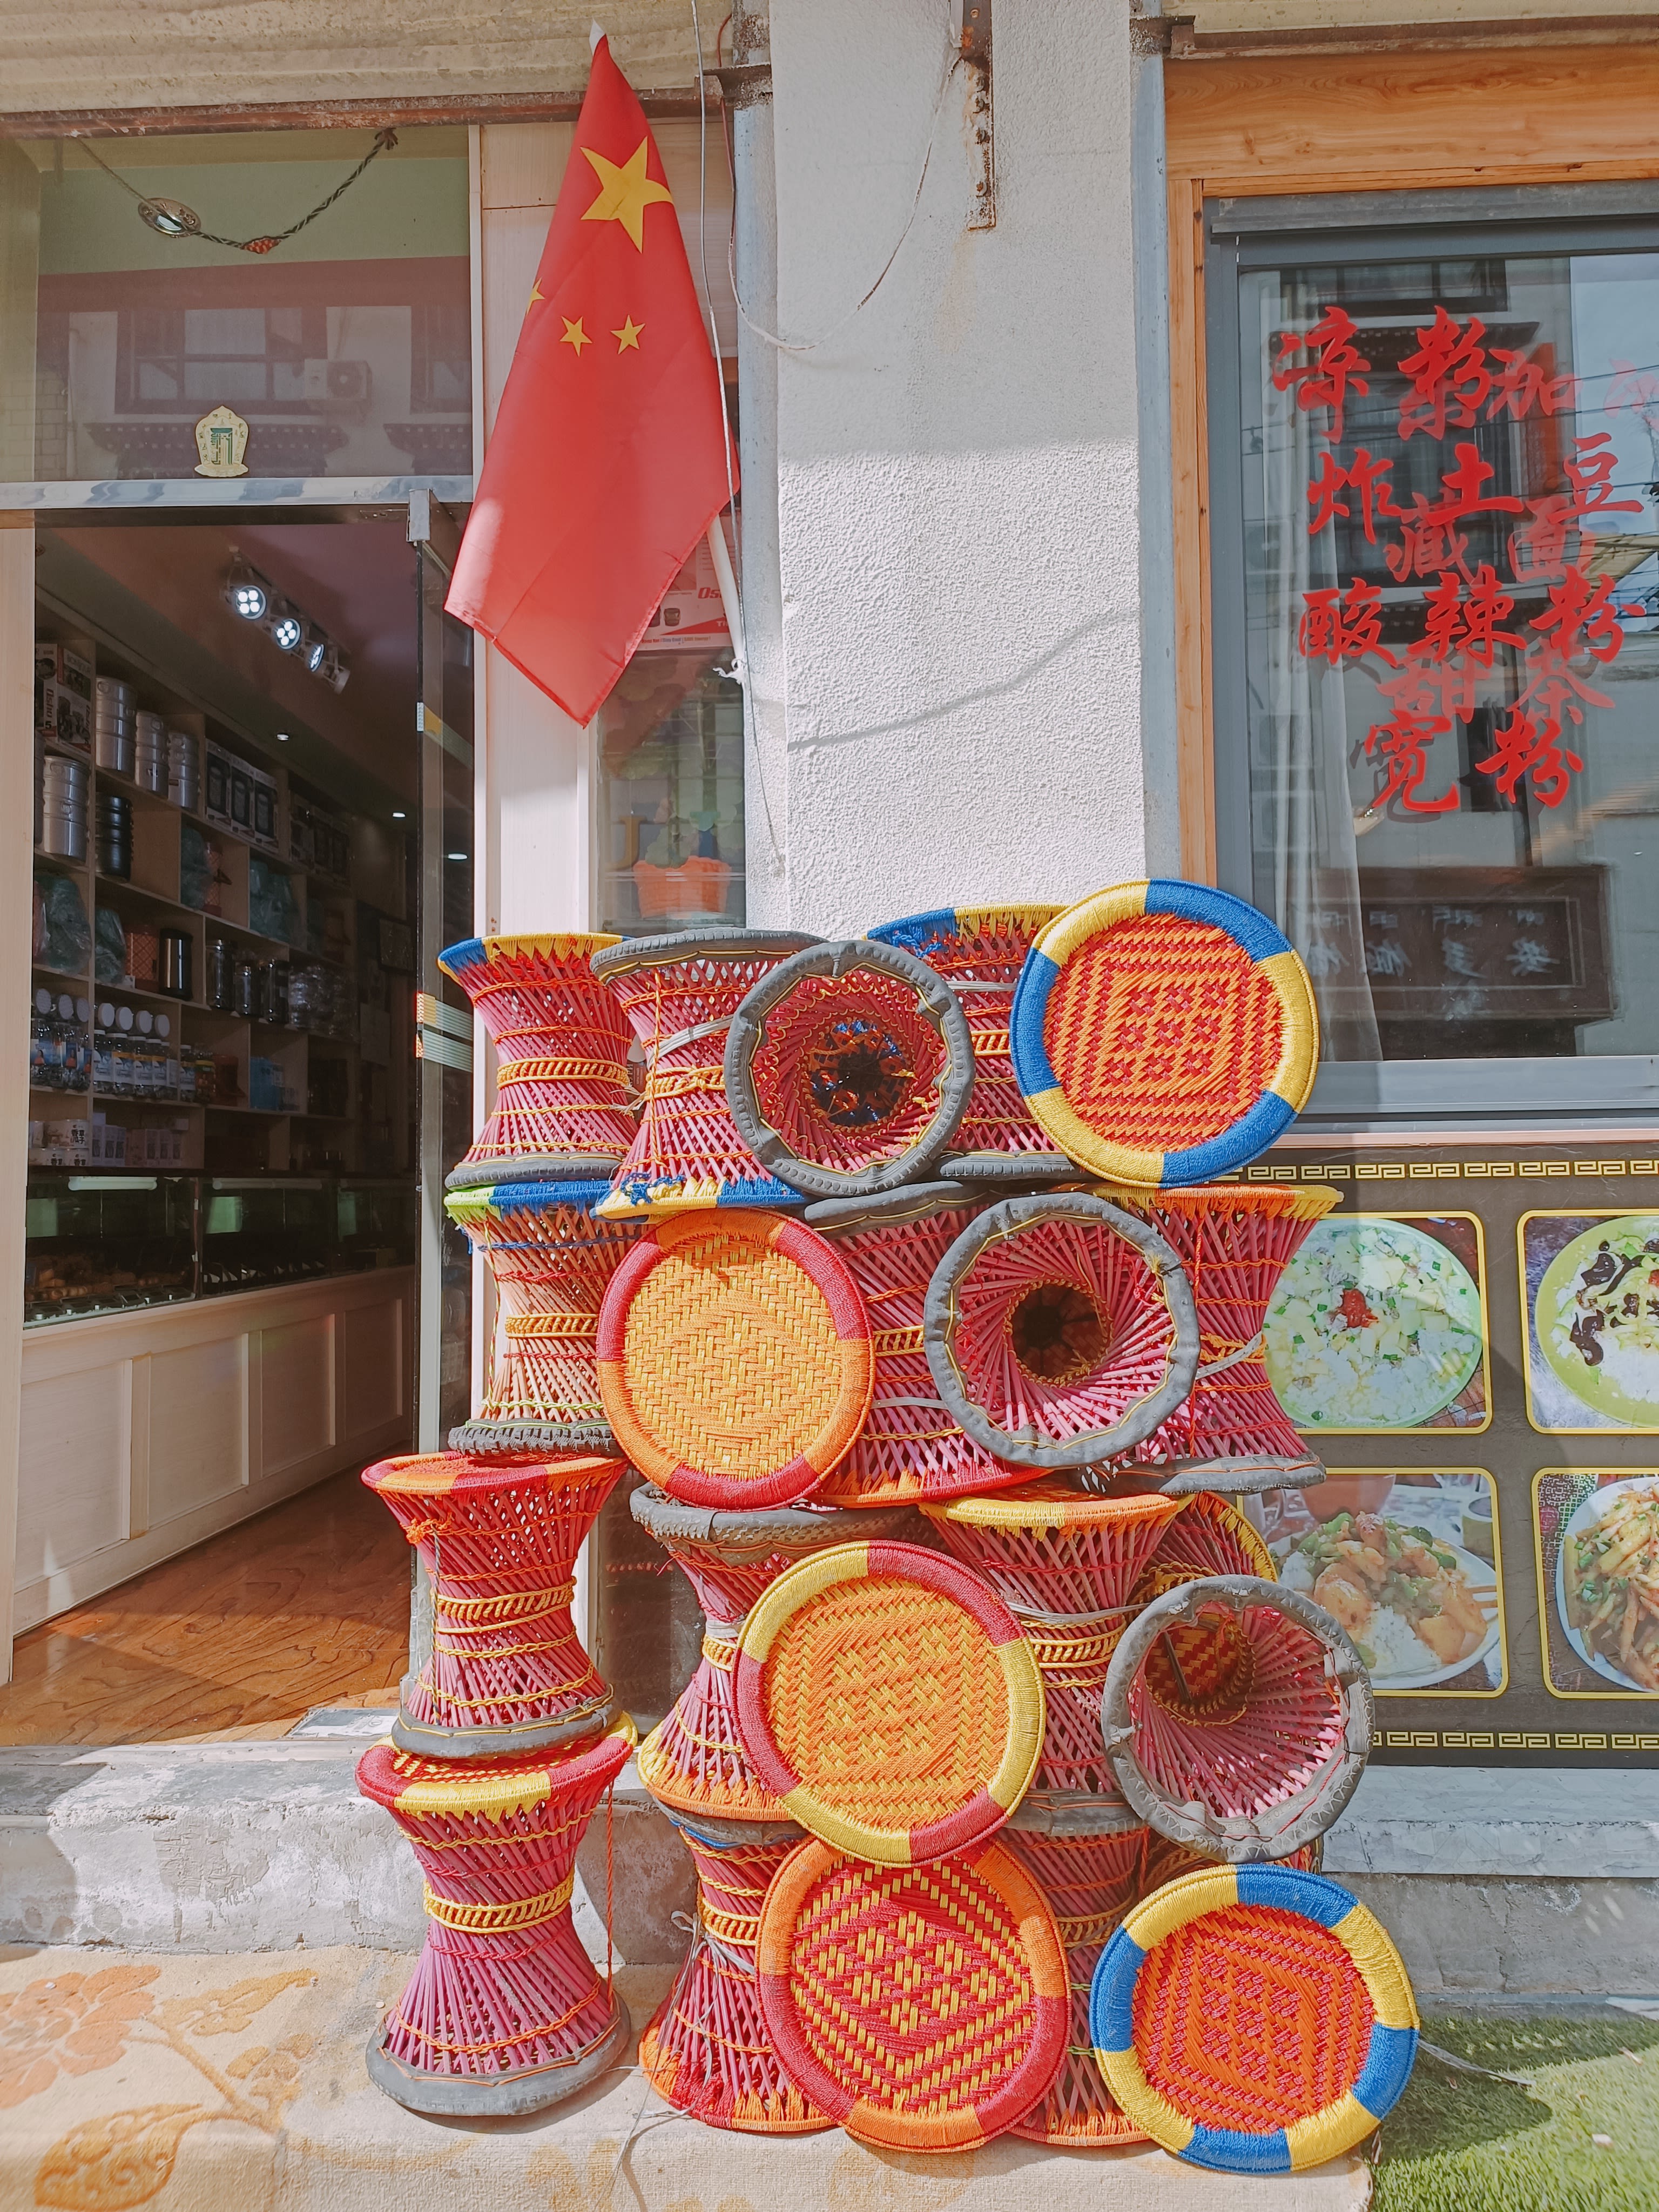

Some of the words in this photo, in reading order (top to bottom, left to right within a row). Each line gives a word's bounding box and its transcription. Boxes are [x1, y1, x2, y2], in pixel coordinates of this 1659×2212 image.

[1274, 306, 1514, 409] 凉粉
[1309, 432, 1644, 545] 炸土豆
[698, 587, 721, 599] Os
[1301, 565, 1646, 668] 酸辣粉
[1365, 705, 1583, 812] 宽粉
